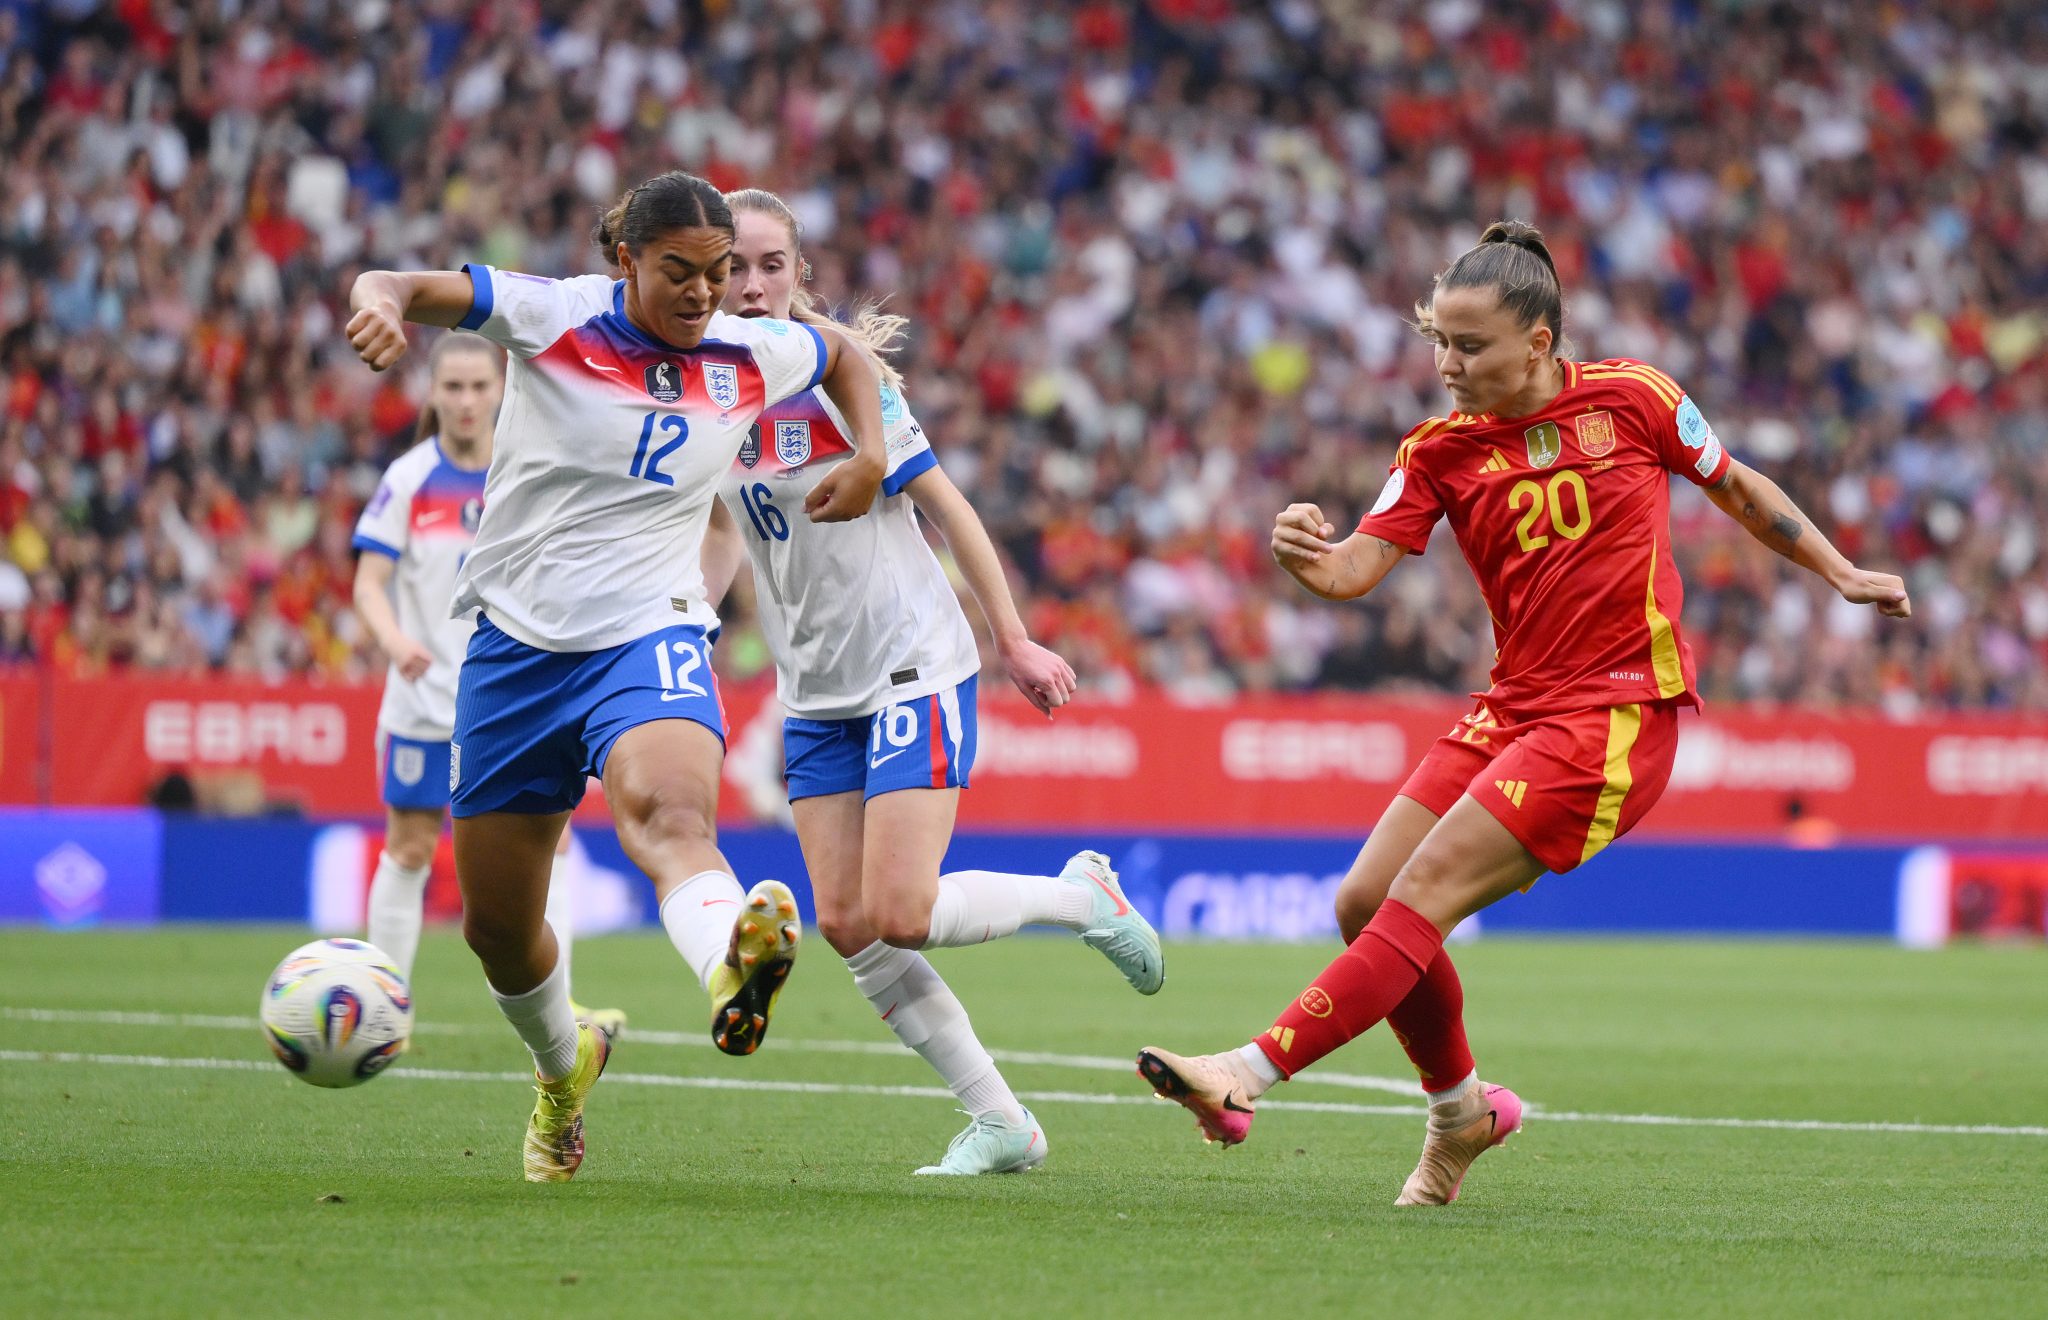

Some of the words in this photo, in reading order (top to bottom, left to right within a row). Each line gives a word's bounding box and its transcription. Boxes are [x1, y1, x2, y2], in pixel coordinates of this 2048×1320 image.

[629, 410, 689, 486] 12
[740, 482, 789, 541] 16
[1508, 470, 1591, 552] 20
[655, 640, 707, 697] 12
[872, 703, 917, 753] 16
